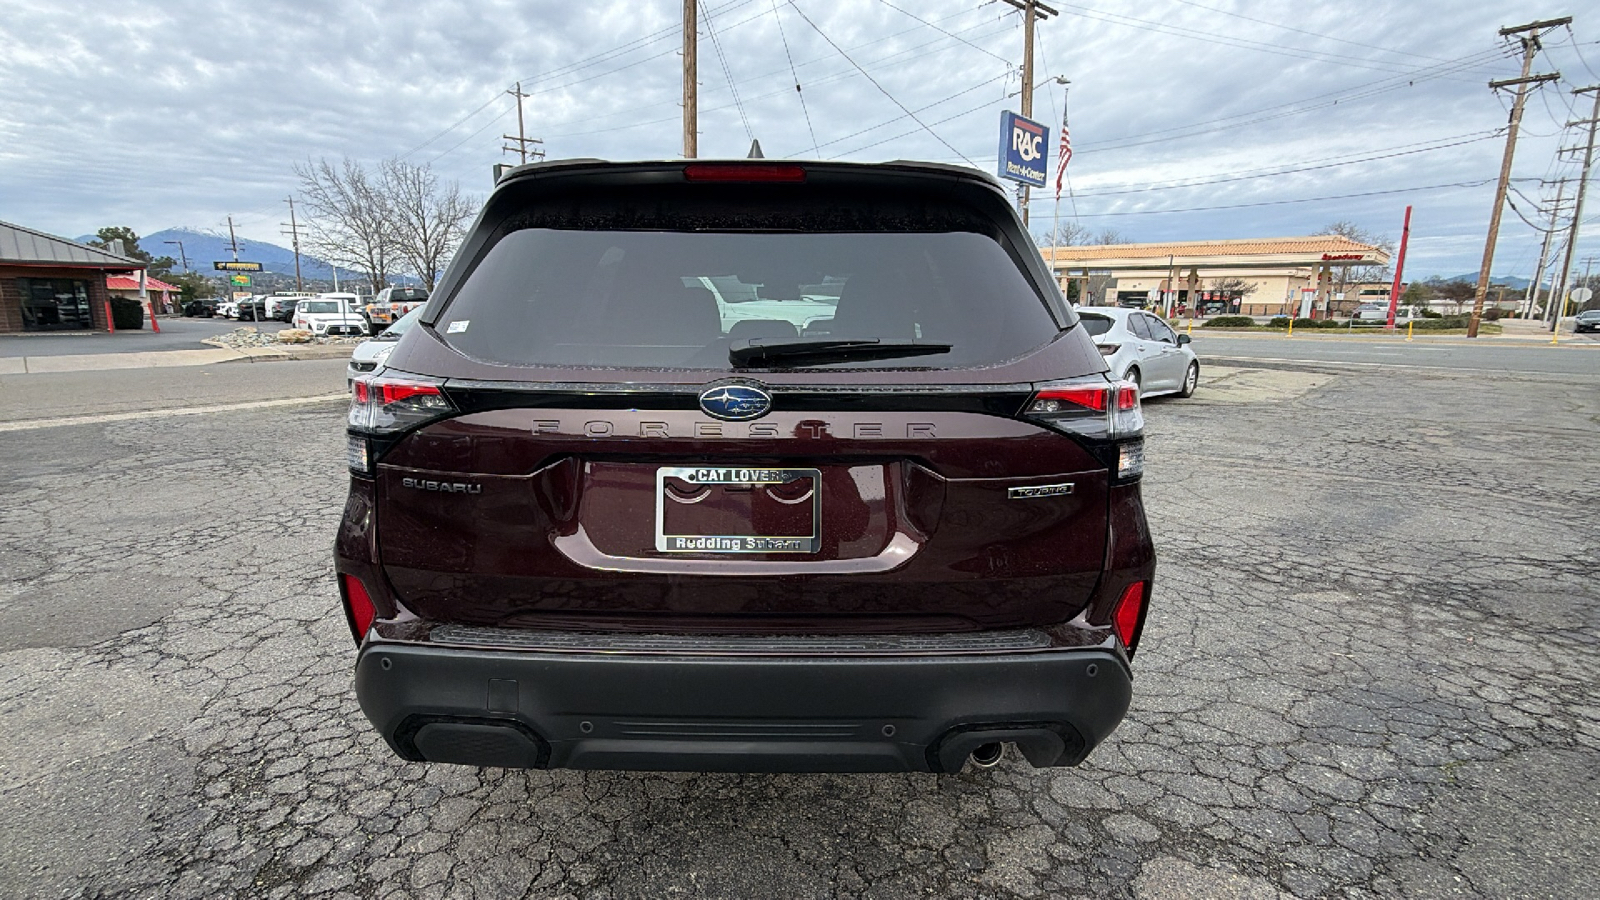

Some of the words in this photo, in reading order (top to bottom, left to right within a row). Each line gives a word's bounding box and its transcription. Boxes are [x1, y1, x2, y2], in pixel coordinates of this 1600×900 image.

[1012, 126, 1043, 162] RAC
[1321, 252, 1366, 261] Speedway
[531, 419, 938, 439] FORESTER
[697, 469, 727, 481] CAT
[731, 469, 780, 481] LOVER
[402, 477, 482, 494] SUBARU
[1017, 485, 1068, 496] TOURING
[675, 537, 741, 550] Redding
[745, 537, 802, 550] Subaru
